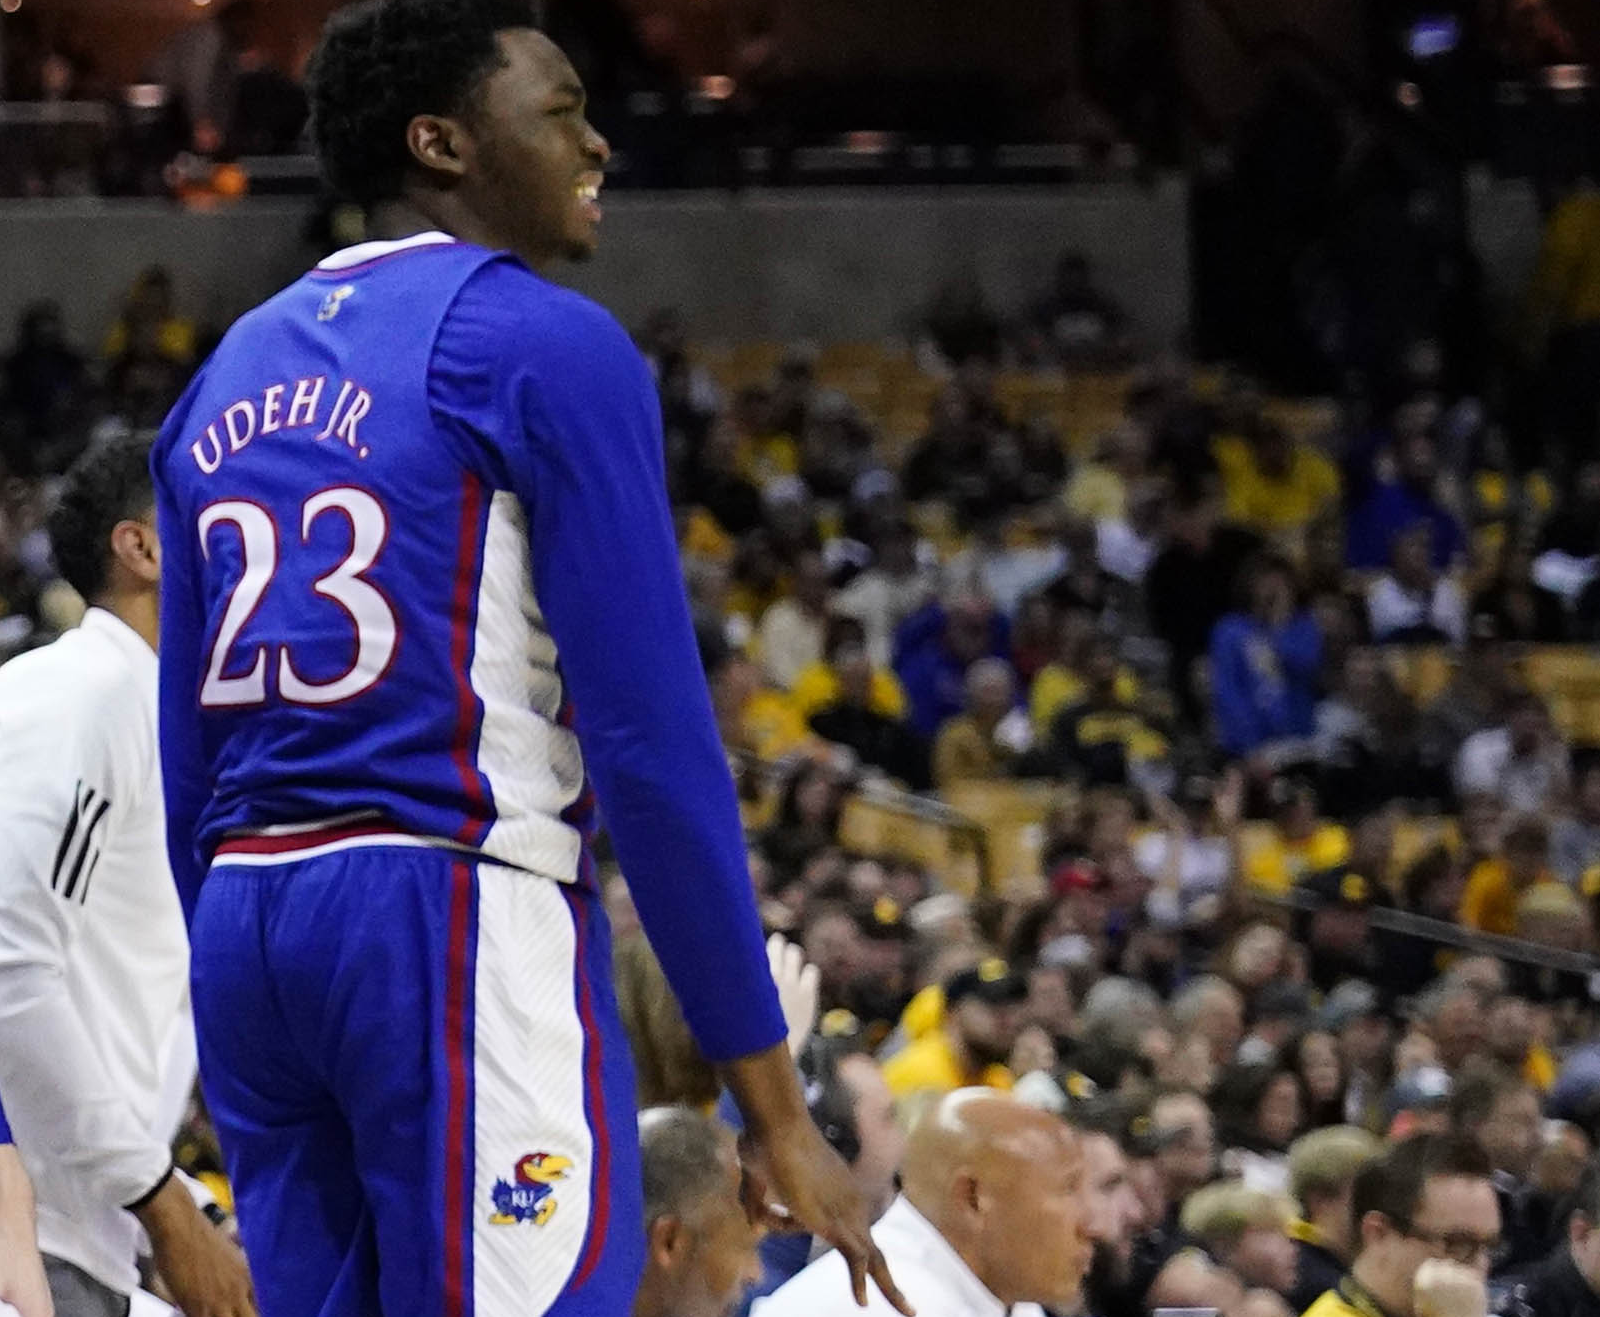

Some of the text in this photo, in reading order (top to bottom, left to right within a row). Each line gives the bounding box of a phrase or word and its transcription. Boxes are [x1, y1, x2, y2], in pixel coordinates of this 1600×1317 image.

[191, 374, 372, 476] UDEH JR.
[196, 483, 401, 708] 23
[511, 1190, 534, 1208] KU
